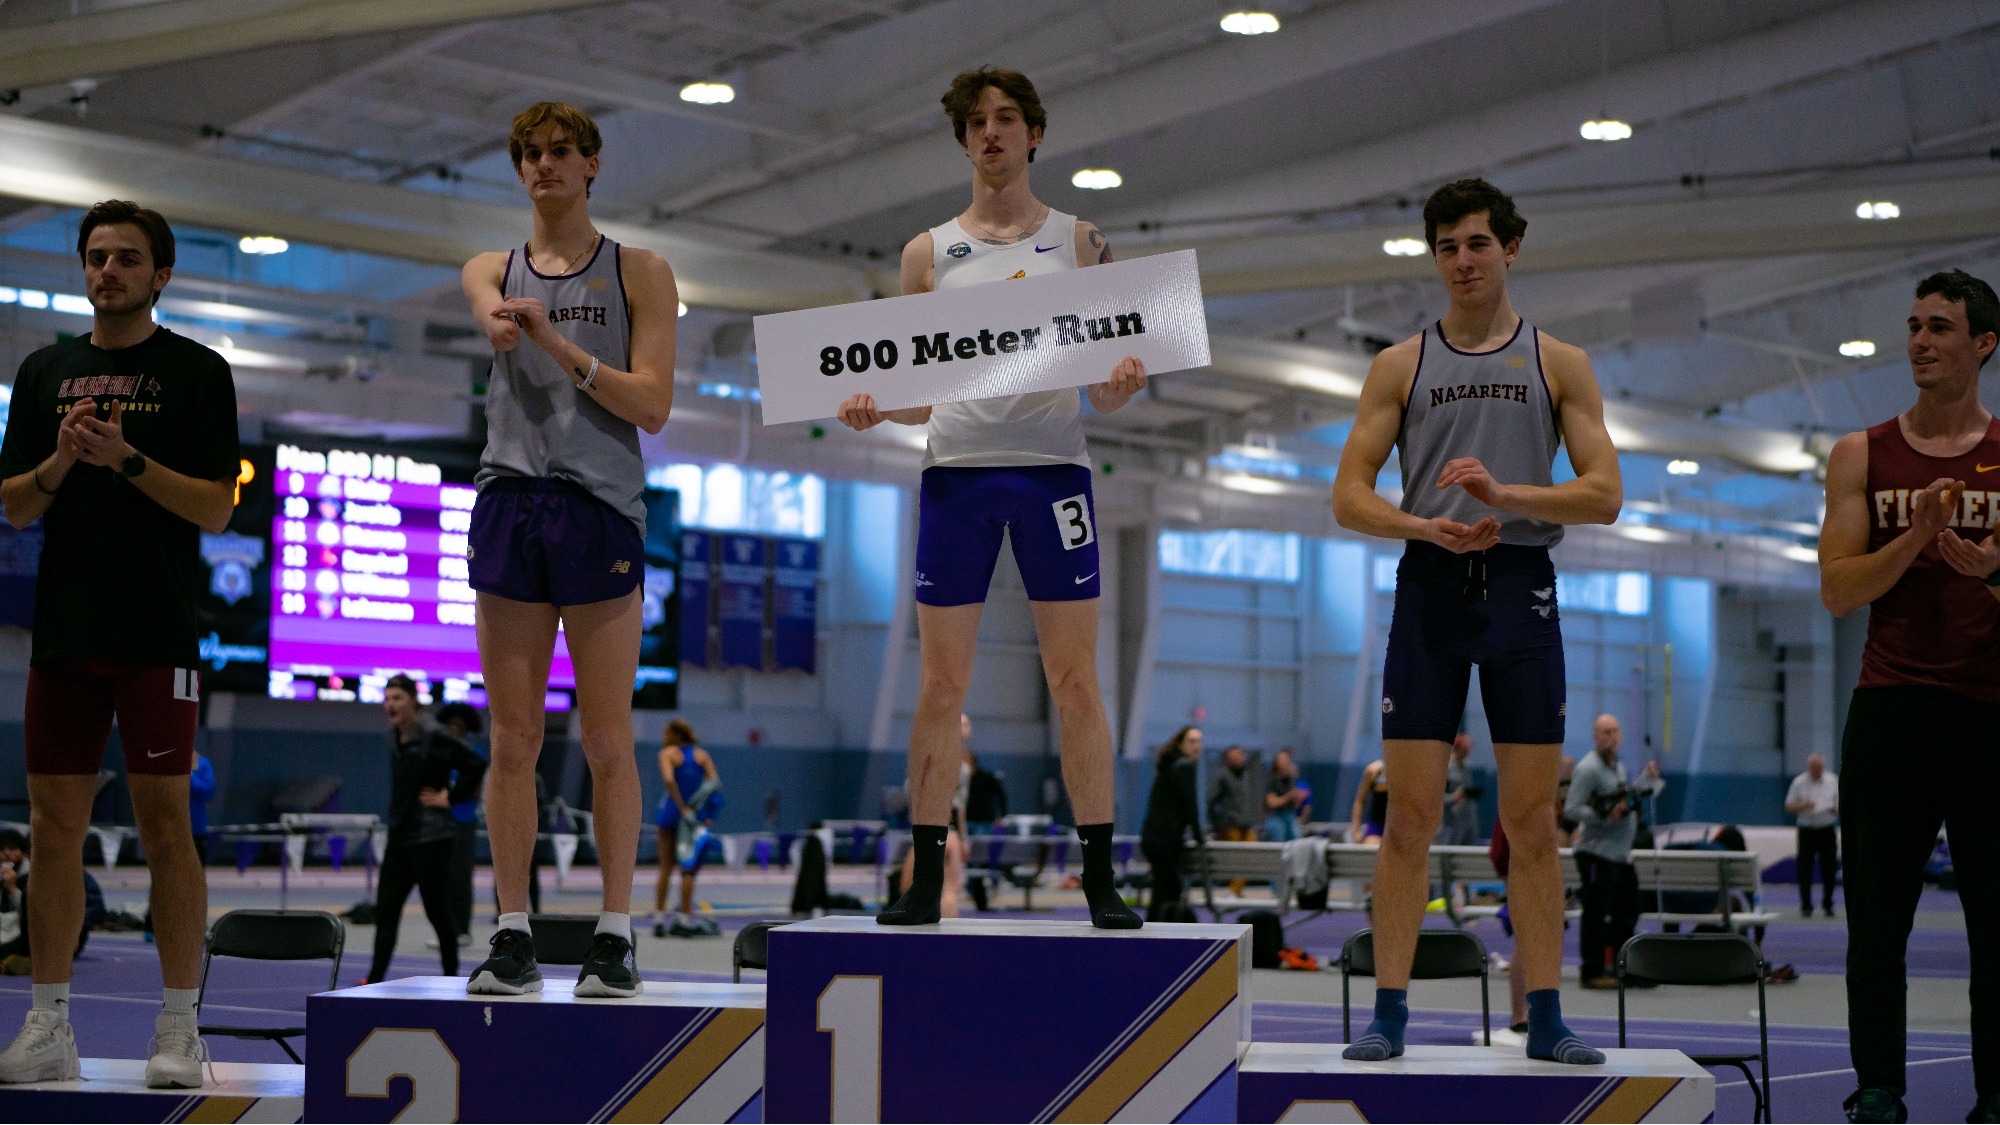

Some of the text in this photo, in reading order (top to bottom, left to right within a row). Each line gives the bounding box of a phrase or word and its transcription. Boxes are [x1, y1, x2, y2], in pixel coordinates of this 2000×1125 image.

[819, 309, 1146, 377] 800 Meter Run
[103, 402, 161, 413] CUNTRY
[1430, 383, 1528, 408] NAZARETH
[1061, 500, 1088, 546] 3
[345, 1026, 460, 1124] 2
[816, 974, 884, 1124] 1
